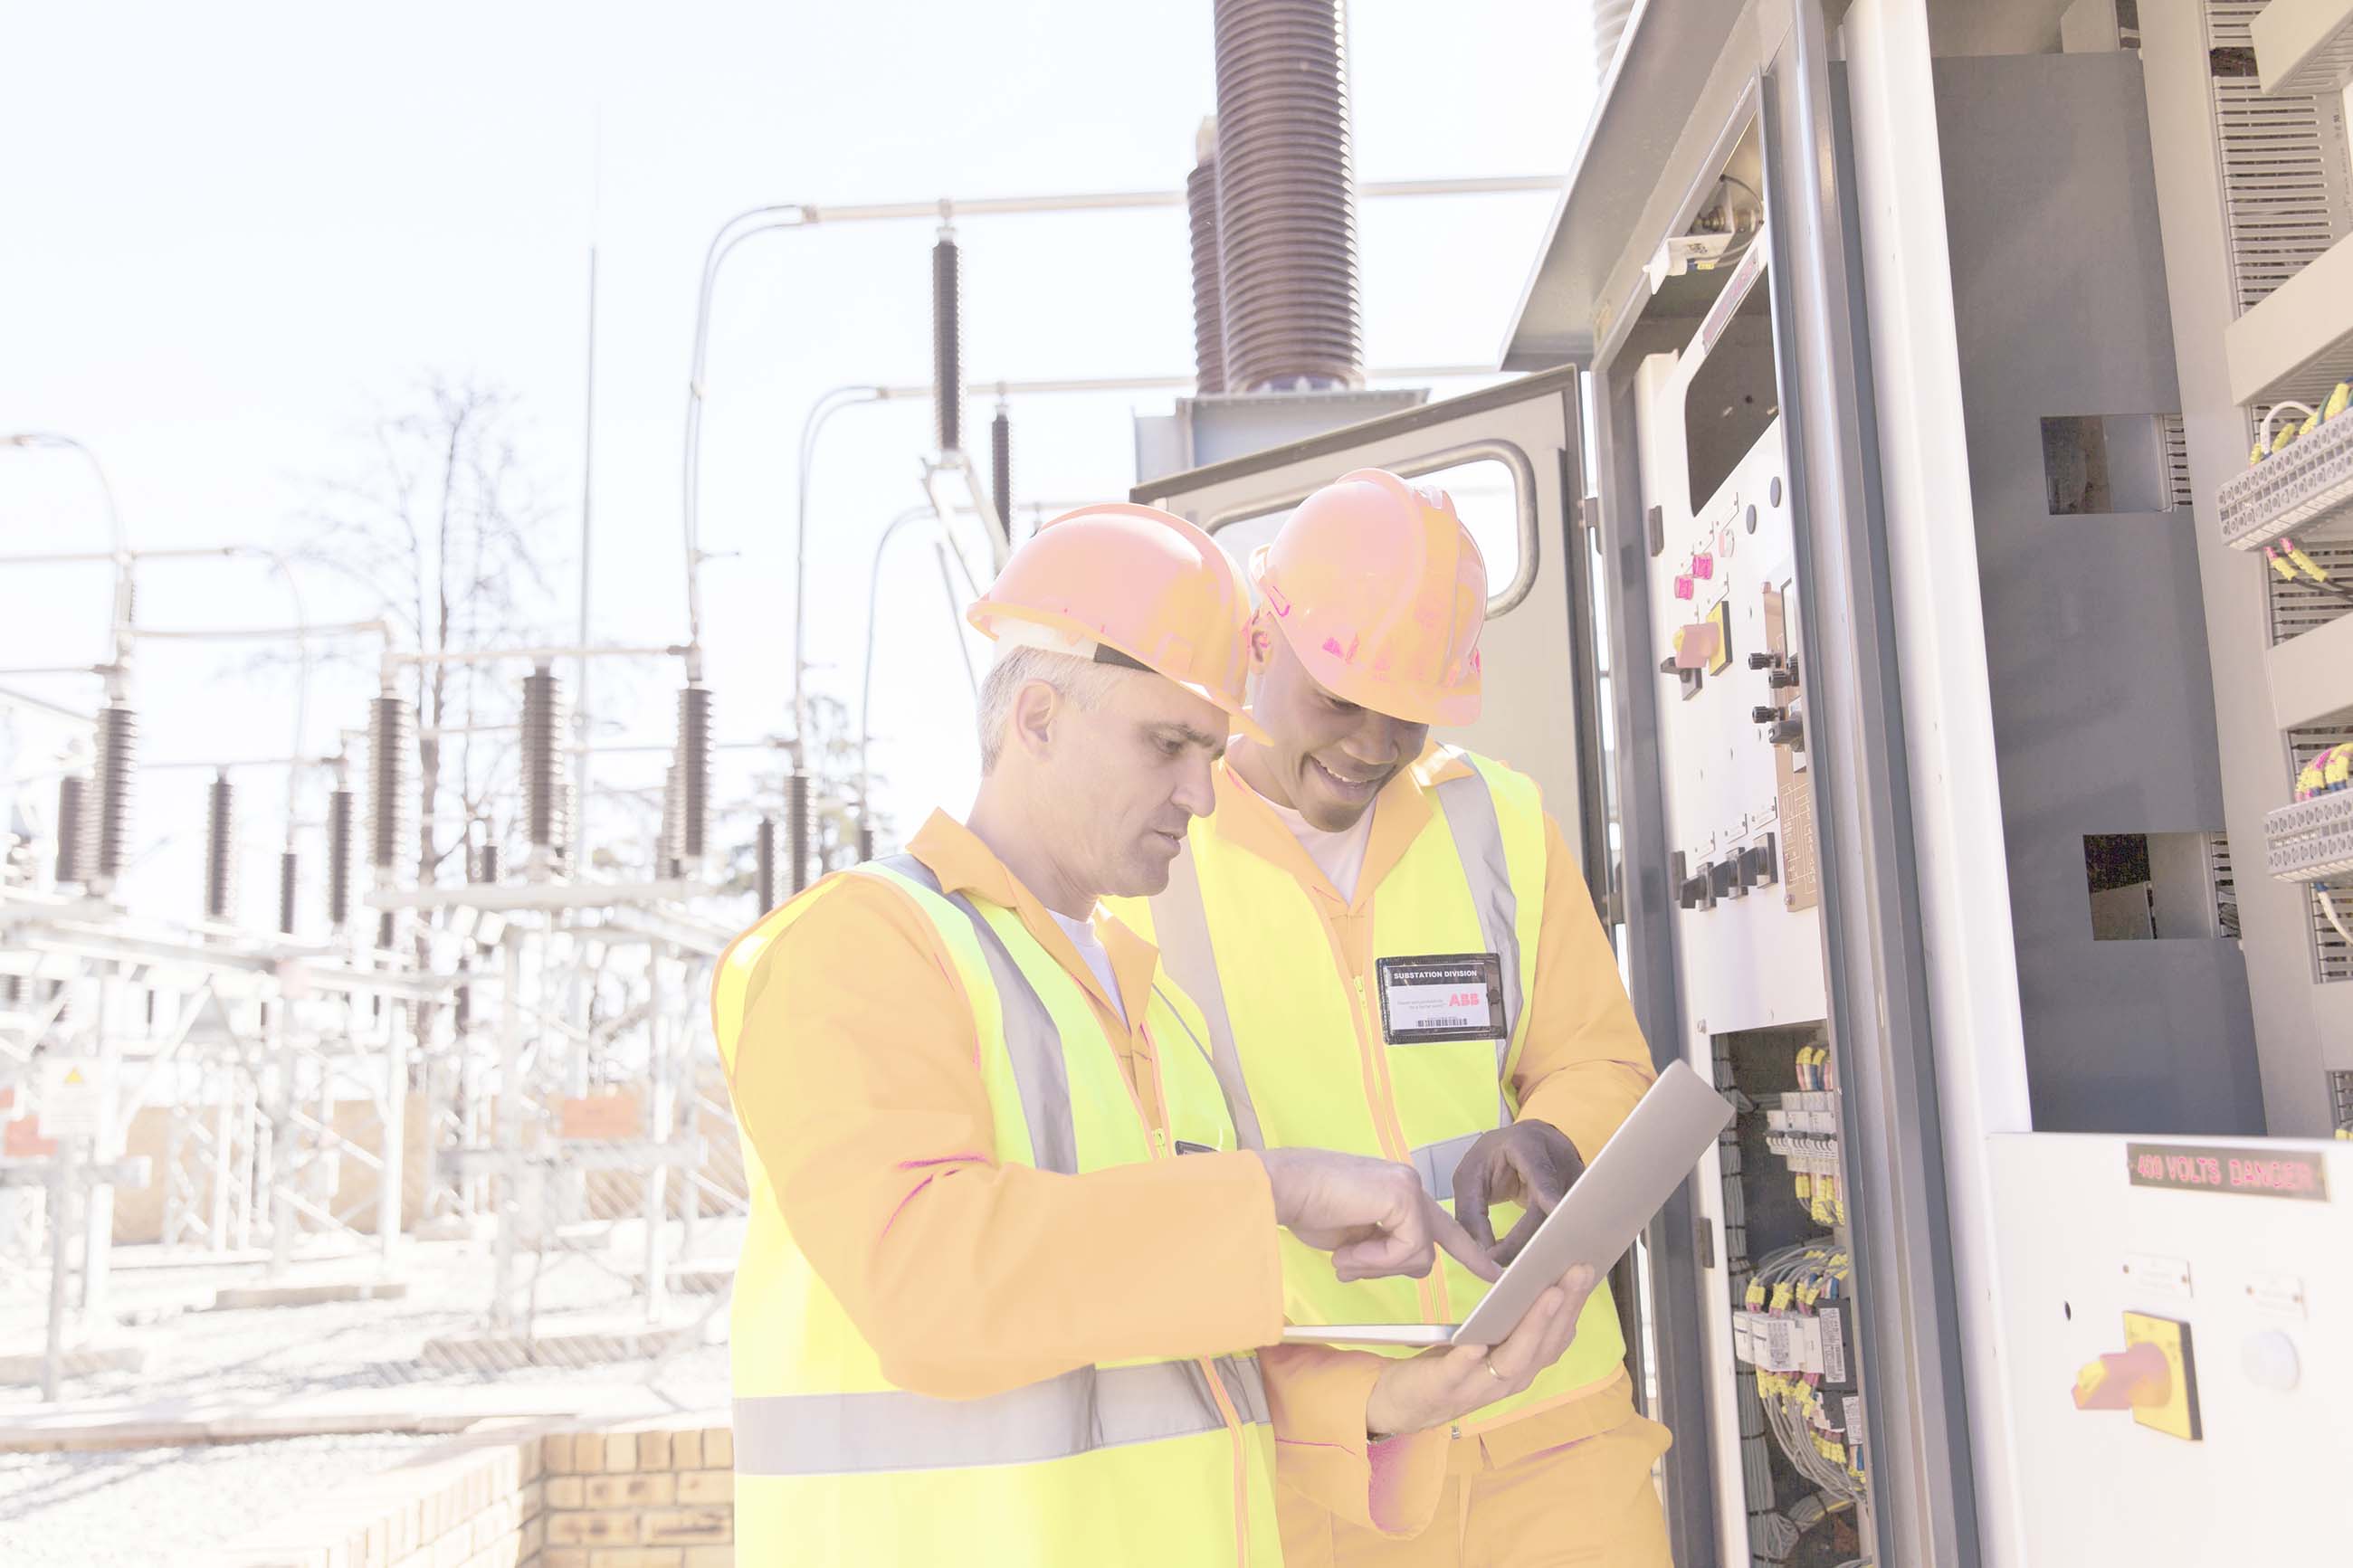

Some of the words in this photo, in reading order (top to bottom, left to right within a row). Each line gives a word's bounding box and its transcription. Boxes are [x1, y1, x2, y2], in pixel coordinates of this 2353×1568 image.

[1394, 971, 1443, 979] SUBSTATION
[1443, 970, 1477, 978] DIVISION
[1449, 993, 1480, 1006] ABB
[2166, 1155, 2221, 1184] VOLTS
[2229, 1158, 2314, 1189] DANGER
